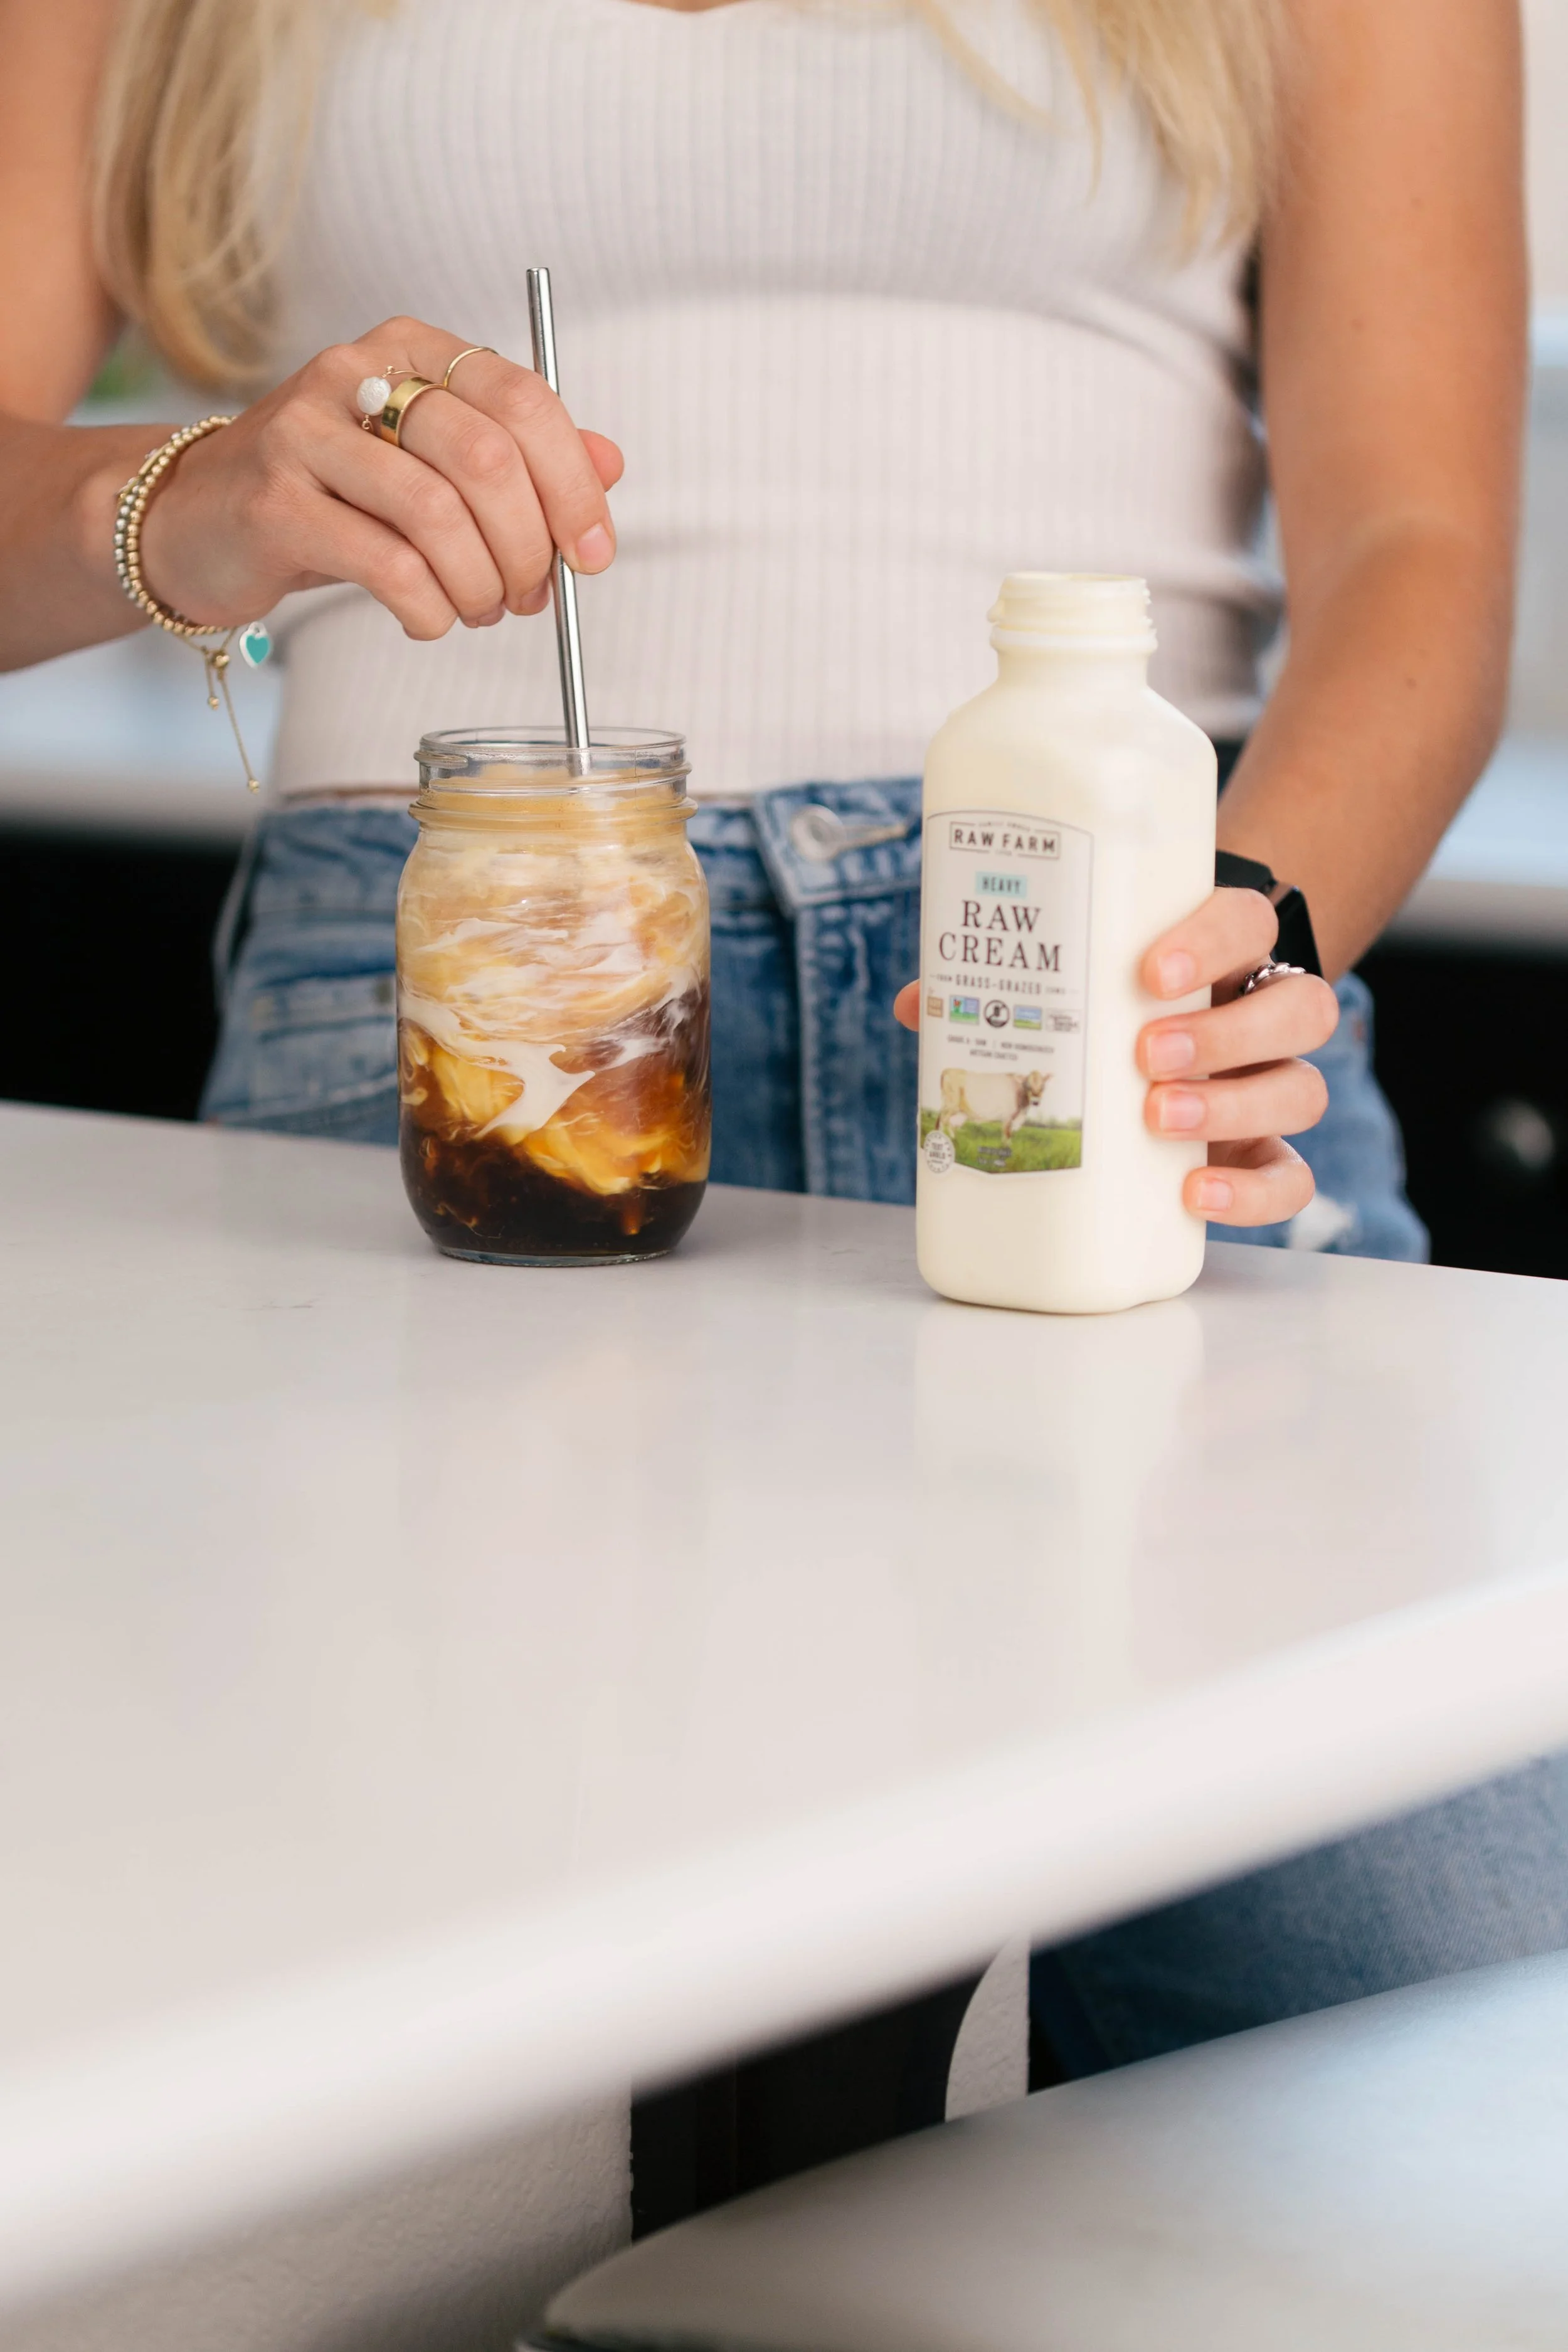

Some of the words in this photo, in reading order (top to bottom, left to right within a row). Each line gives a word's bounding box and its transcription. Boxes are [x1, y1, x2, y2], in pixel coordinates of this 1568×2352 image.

[954, 829, 994, 847] RAW
[1002, 833, 1056, 852] FARM
[982, 876, 1021, 894] HEAVY
[961, 899, 1042, 933] RAW
[938, 931, 1062, 973] CREAM
